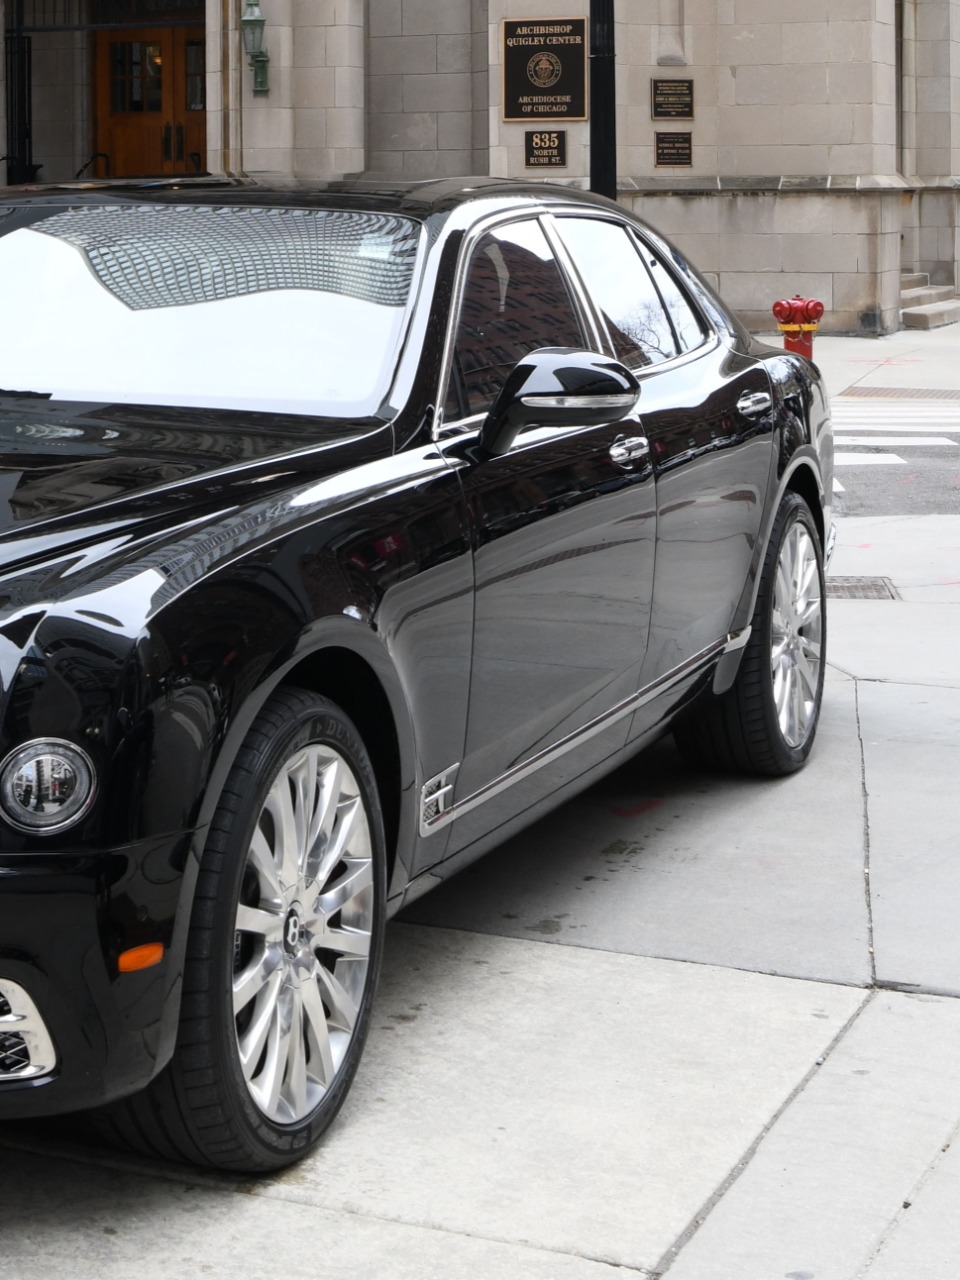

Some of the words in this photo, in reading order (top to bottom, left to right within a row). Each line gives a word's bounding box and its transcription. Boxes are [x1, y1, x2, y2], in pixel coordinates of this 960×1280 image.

[515, 25, 573, 35] ARCHBISHOP
[506, 36, 546, 47] QUIGLEY
[546, 35, 582, 45] CENTER
[517, 95, 572, 104] ARCHDIOCESE
[533, 104, 568, 112] CHICAGO
[532, 133, 559, 148] 835
[287, 916, 299, 946] B
